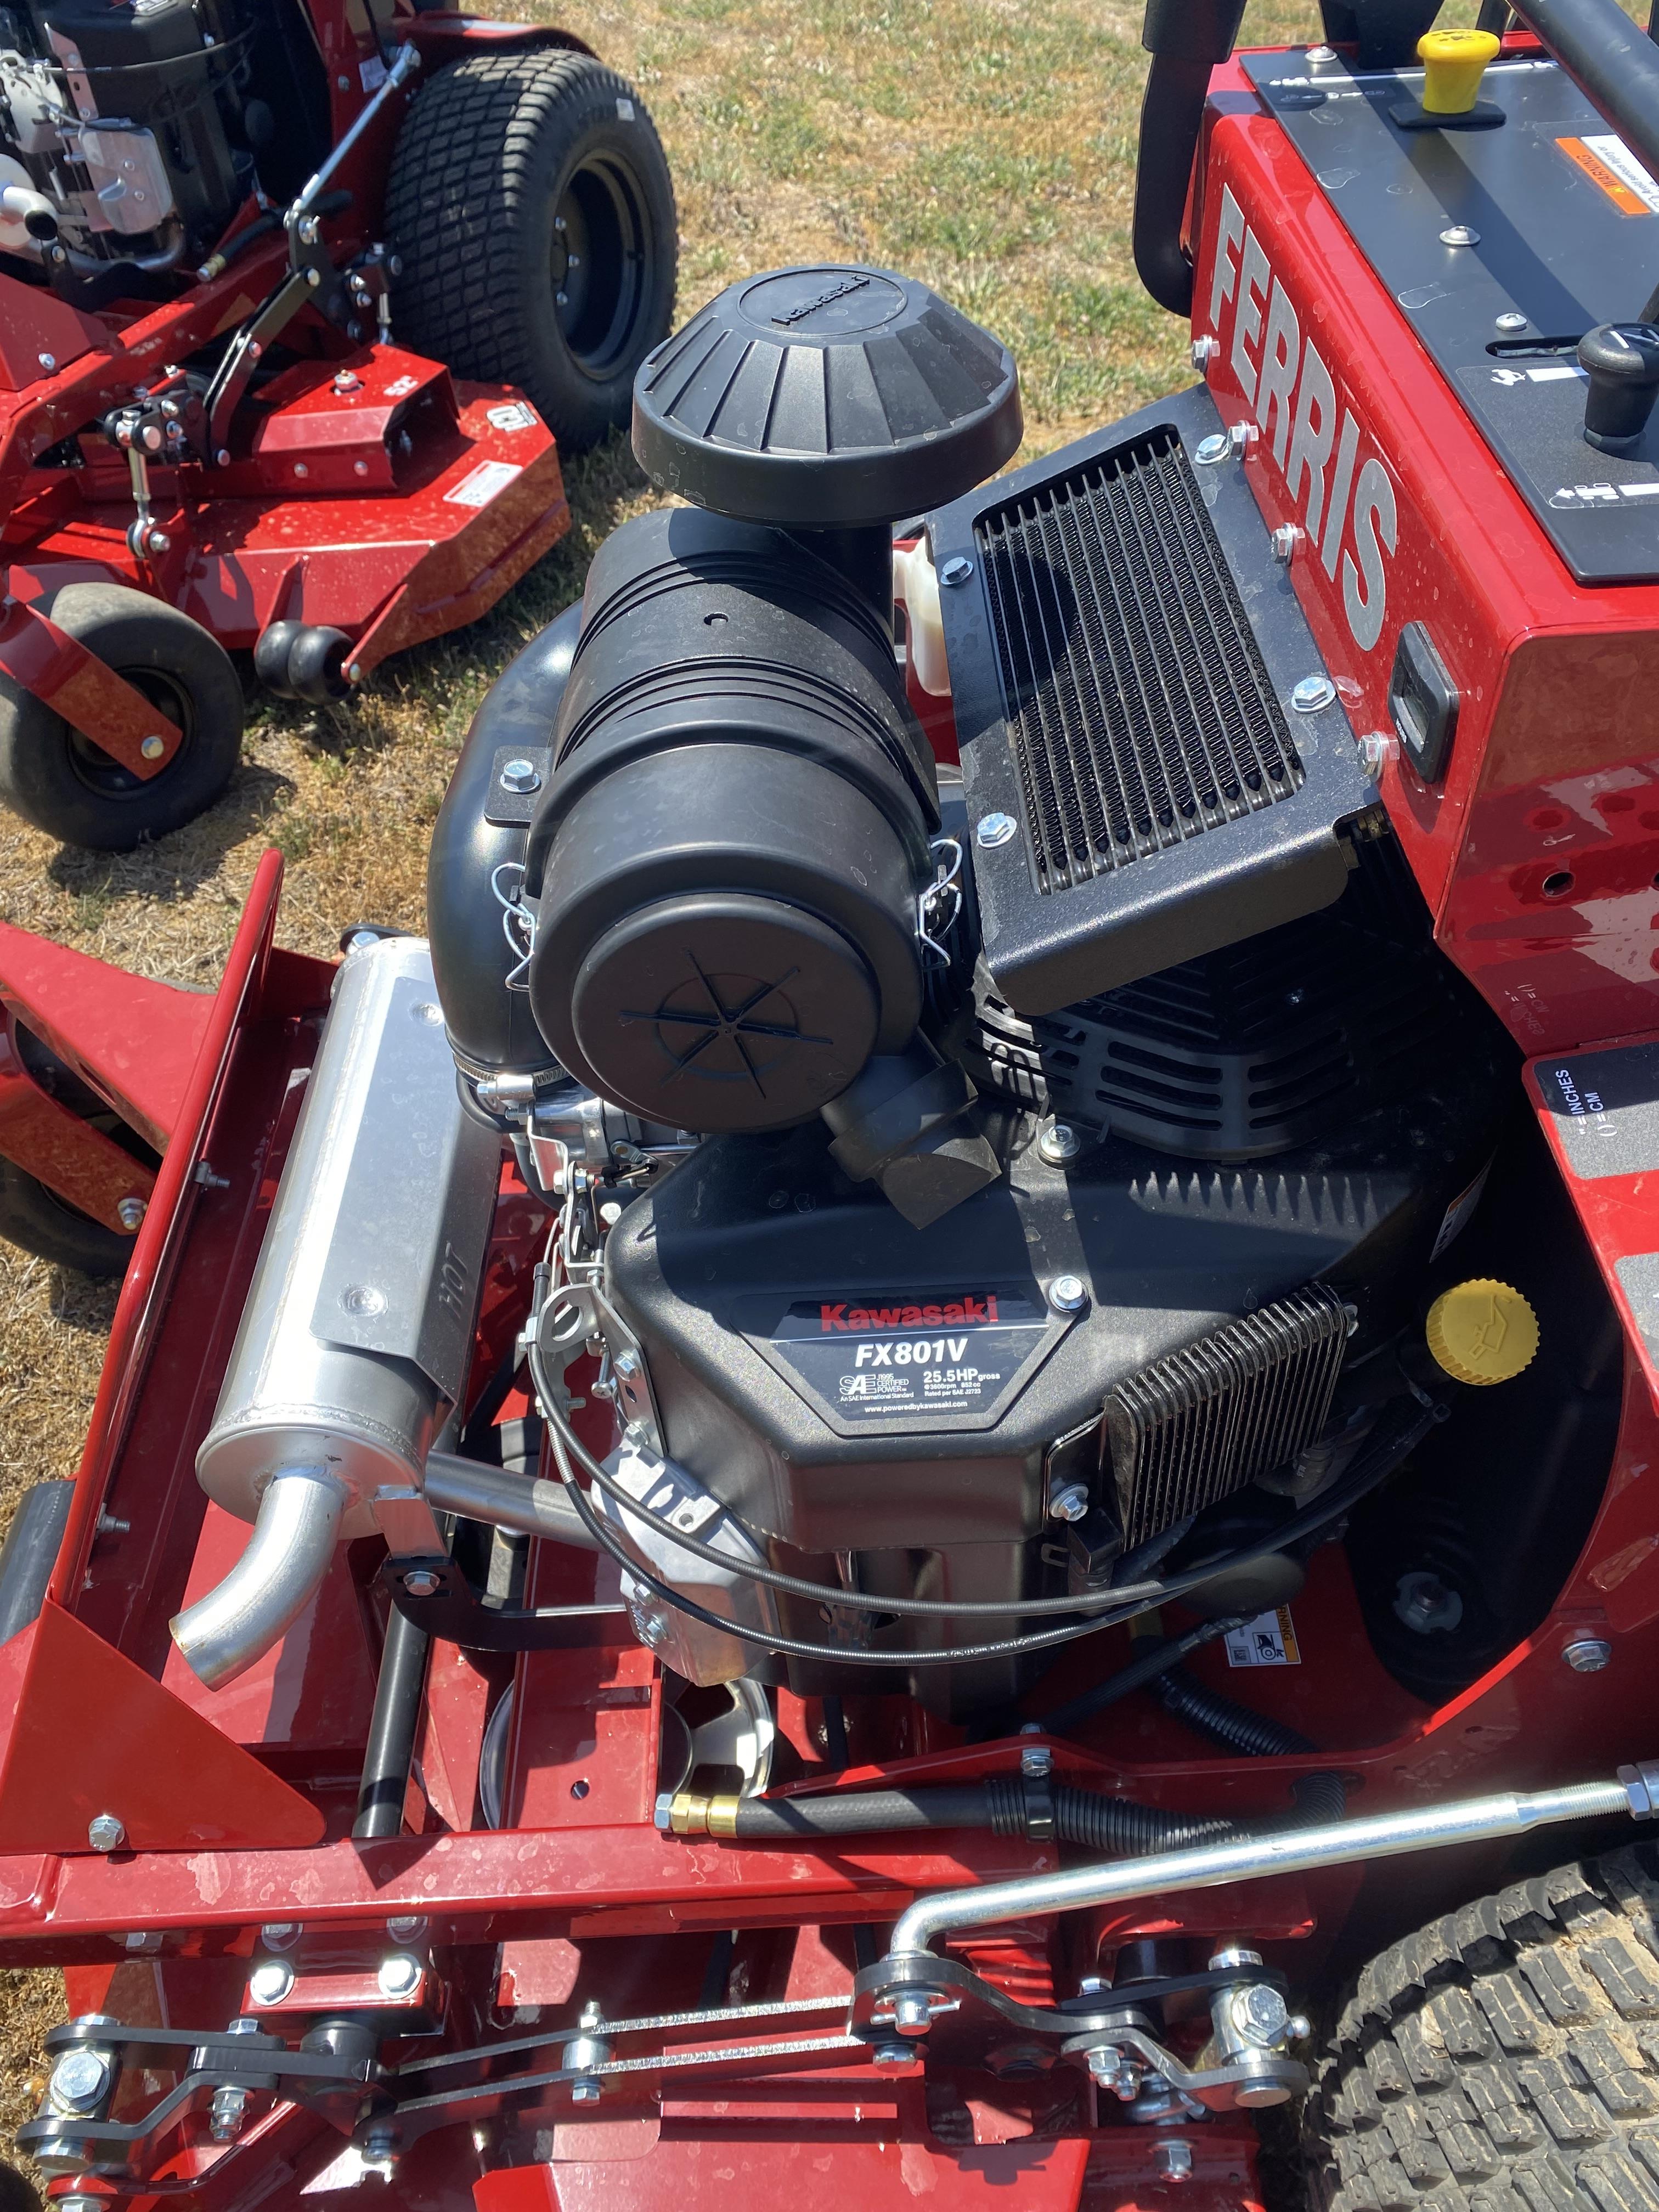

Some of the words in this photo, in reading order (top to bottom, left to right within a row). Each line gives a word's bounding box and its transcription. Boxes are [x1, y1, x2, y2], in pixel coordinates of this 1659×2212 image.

[1602, 152, 1621, 164] injury
[1576, 155, 1617, 187] WARNING
[1617, 165, 1639, 180] serious
[1632, 182, 1653, 194] Avoid
[1210, 182, 1398, 652] FERRIS
[1555, 1069, 1585, 1115] INCHES
[1584, 1092, 1604, 1111] CM
[439, 1242, 469, 1319] HOT
[821, 1296, 998, 1331] Kawasaki
[855, 1338, 968, 1367] FX801V
[839, 1374, 877, 1395] SAE
[877, 1379, 909, 1387] CERTIFIED
[978, 1373, 1001, 1381] gross
[865, 1401, 968, 1413] www.poweredbykawasaki.com
[1277, 1606, 1293, 1641] RNING
